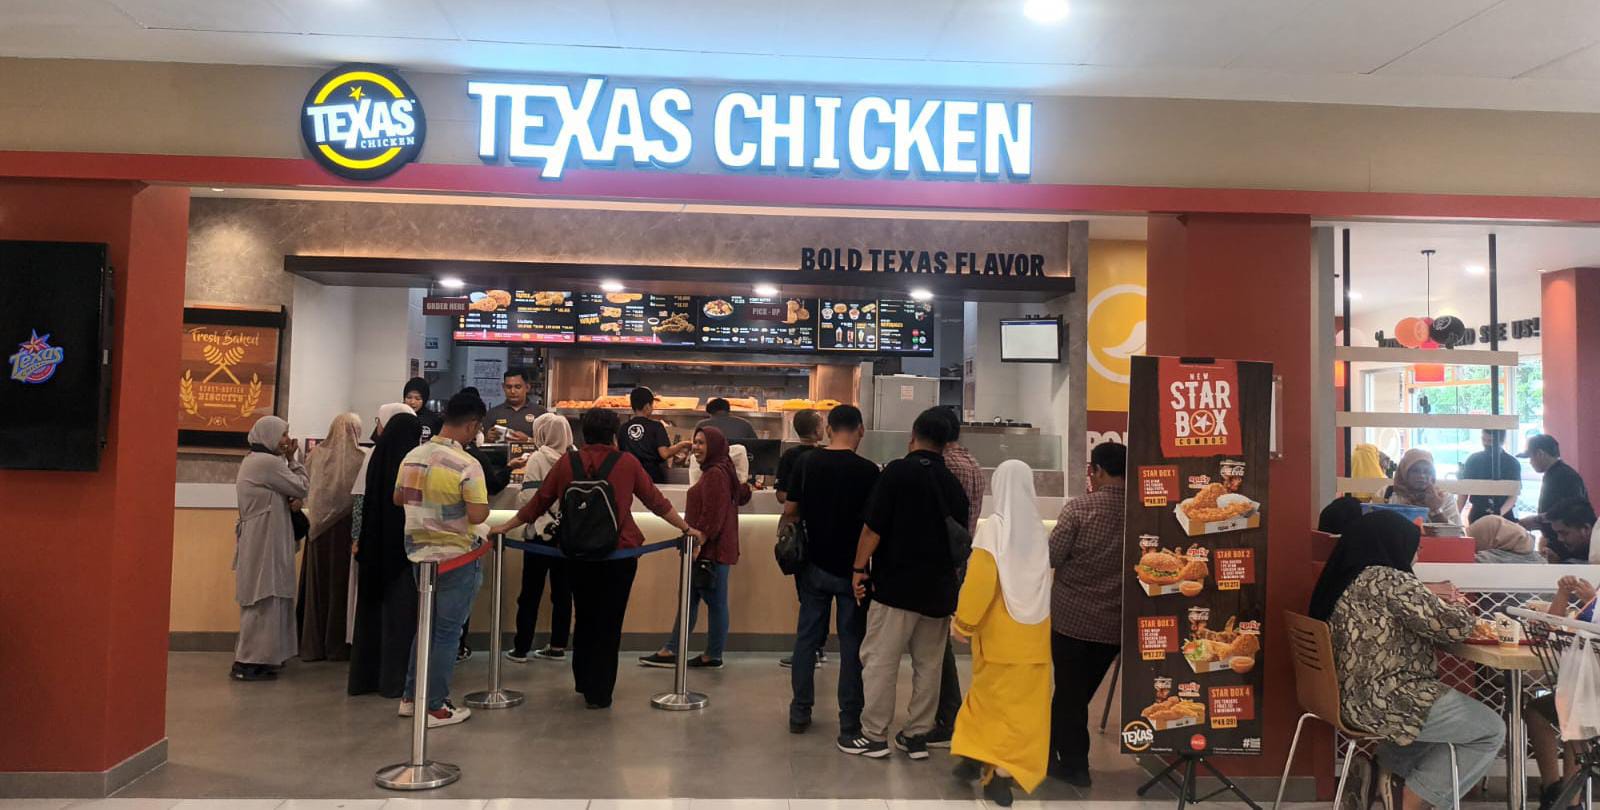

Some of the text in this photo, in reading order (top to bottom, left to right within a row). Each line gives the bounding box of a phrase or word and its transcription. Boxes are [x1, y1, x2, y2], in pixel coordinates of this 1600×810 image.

[307, 99, 415, 149] TEXAS
[467, 77, 1033, 179] TEXAS CHICKEN
[361, 137, 415, 148] CHICKEN
[801, 247, 1046, 277] BOLD TEXAS FLAVOR
[188, 326, 259, 346] Fresh Baked
[9, 347, 64, 379] Texas
[1190, 372, 1209, 380] NEW
[1170, 380, 1231, 409] STAR
[1175, 408, 1229, 437] BOX
[1179, 437, 1225, 445] COMBOS
[1212, 688, 1229, 698] STAR
[1230, 688, 1244, 697] BOX
[1122, 729, 1154, 745] TEXAS
